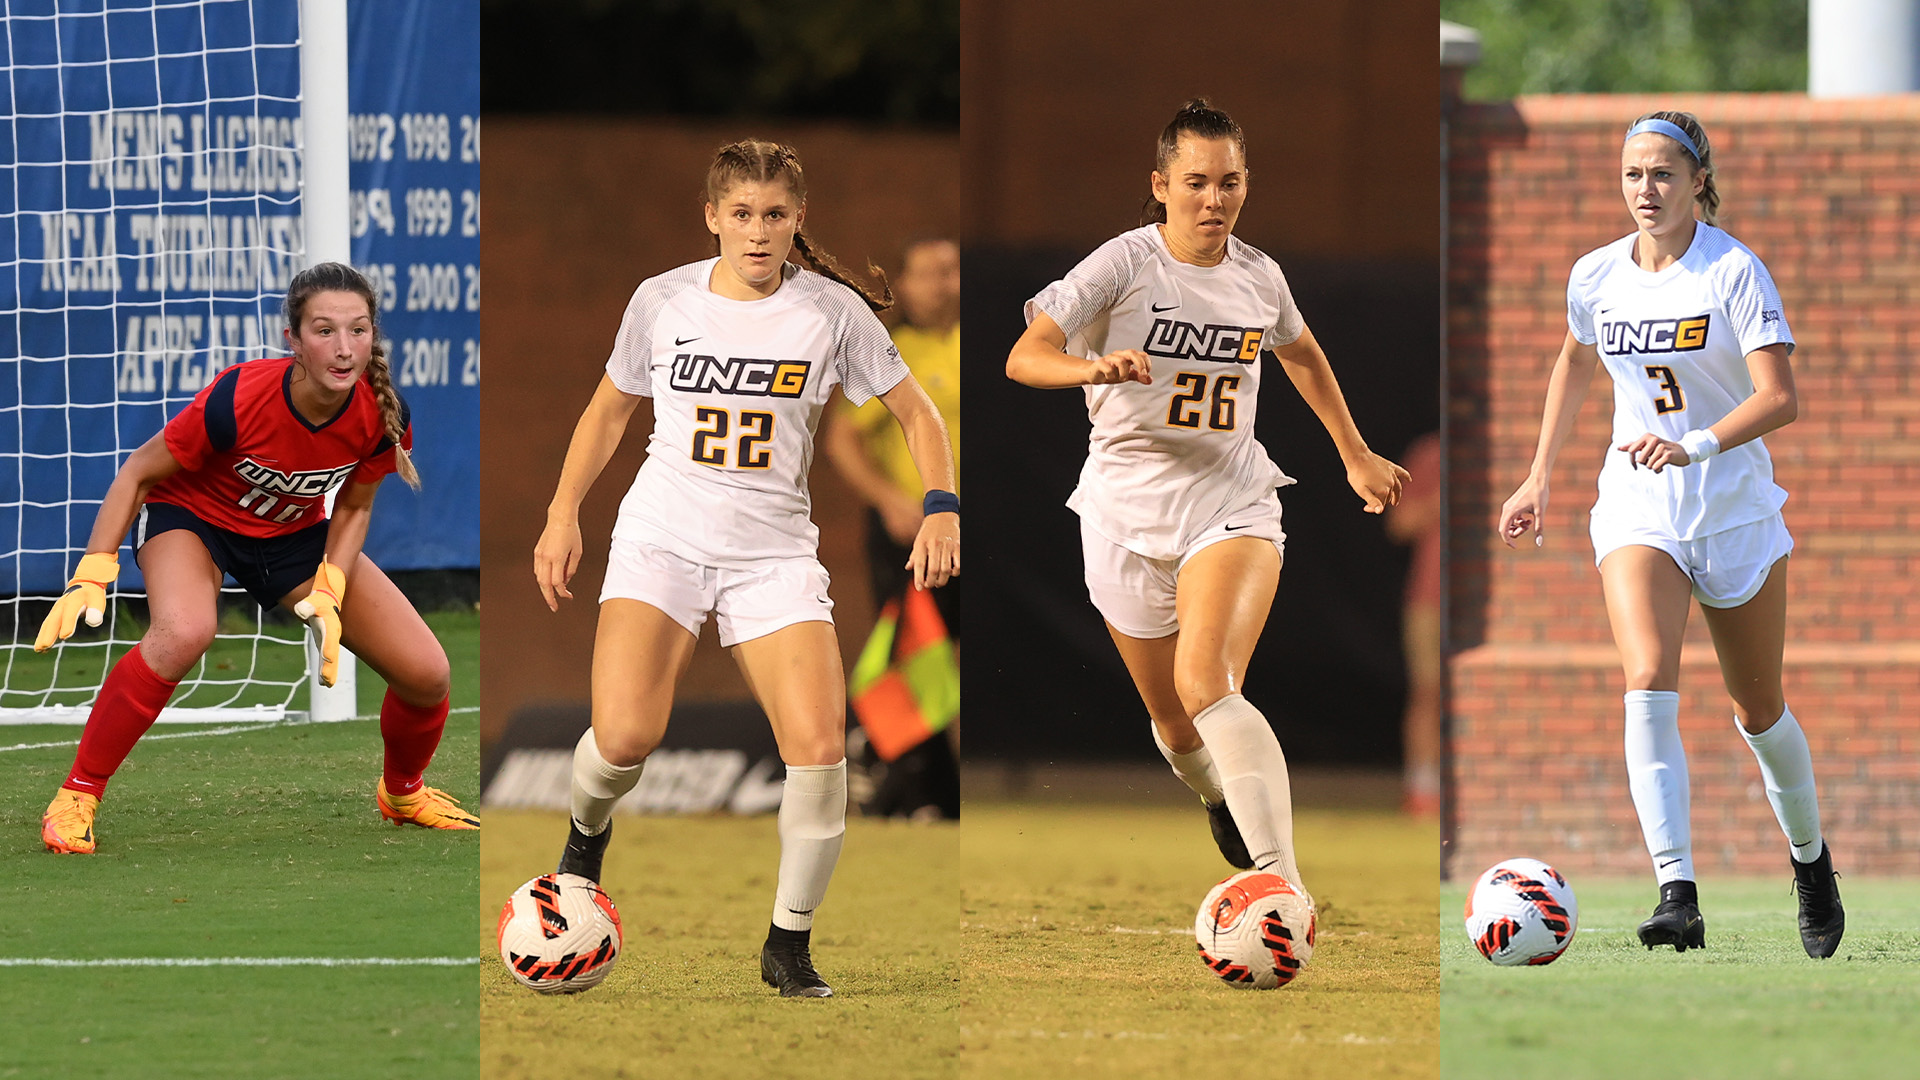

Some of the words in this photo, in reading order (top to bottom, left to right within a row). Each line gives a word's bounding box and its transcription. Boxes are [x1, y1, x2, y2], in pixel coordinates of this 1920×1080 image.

[400, 112, 451, 162] 1998
[405, 187, 453, 237] 1999
[40, 213, 123, 292] NCAA
[406, 262, 460, 312] 2000
[1143, 319, 1264, 364] UNCG
[1602, 314, 1710, 355] UNCG
[400, 338, 451, 387] 2011
[670, 354, 811, 398] UNCG
[1166, 372, 1241, 432] 26
[1645, 364, 1686, 415] 3
[692, 405, 775, 469] 22
